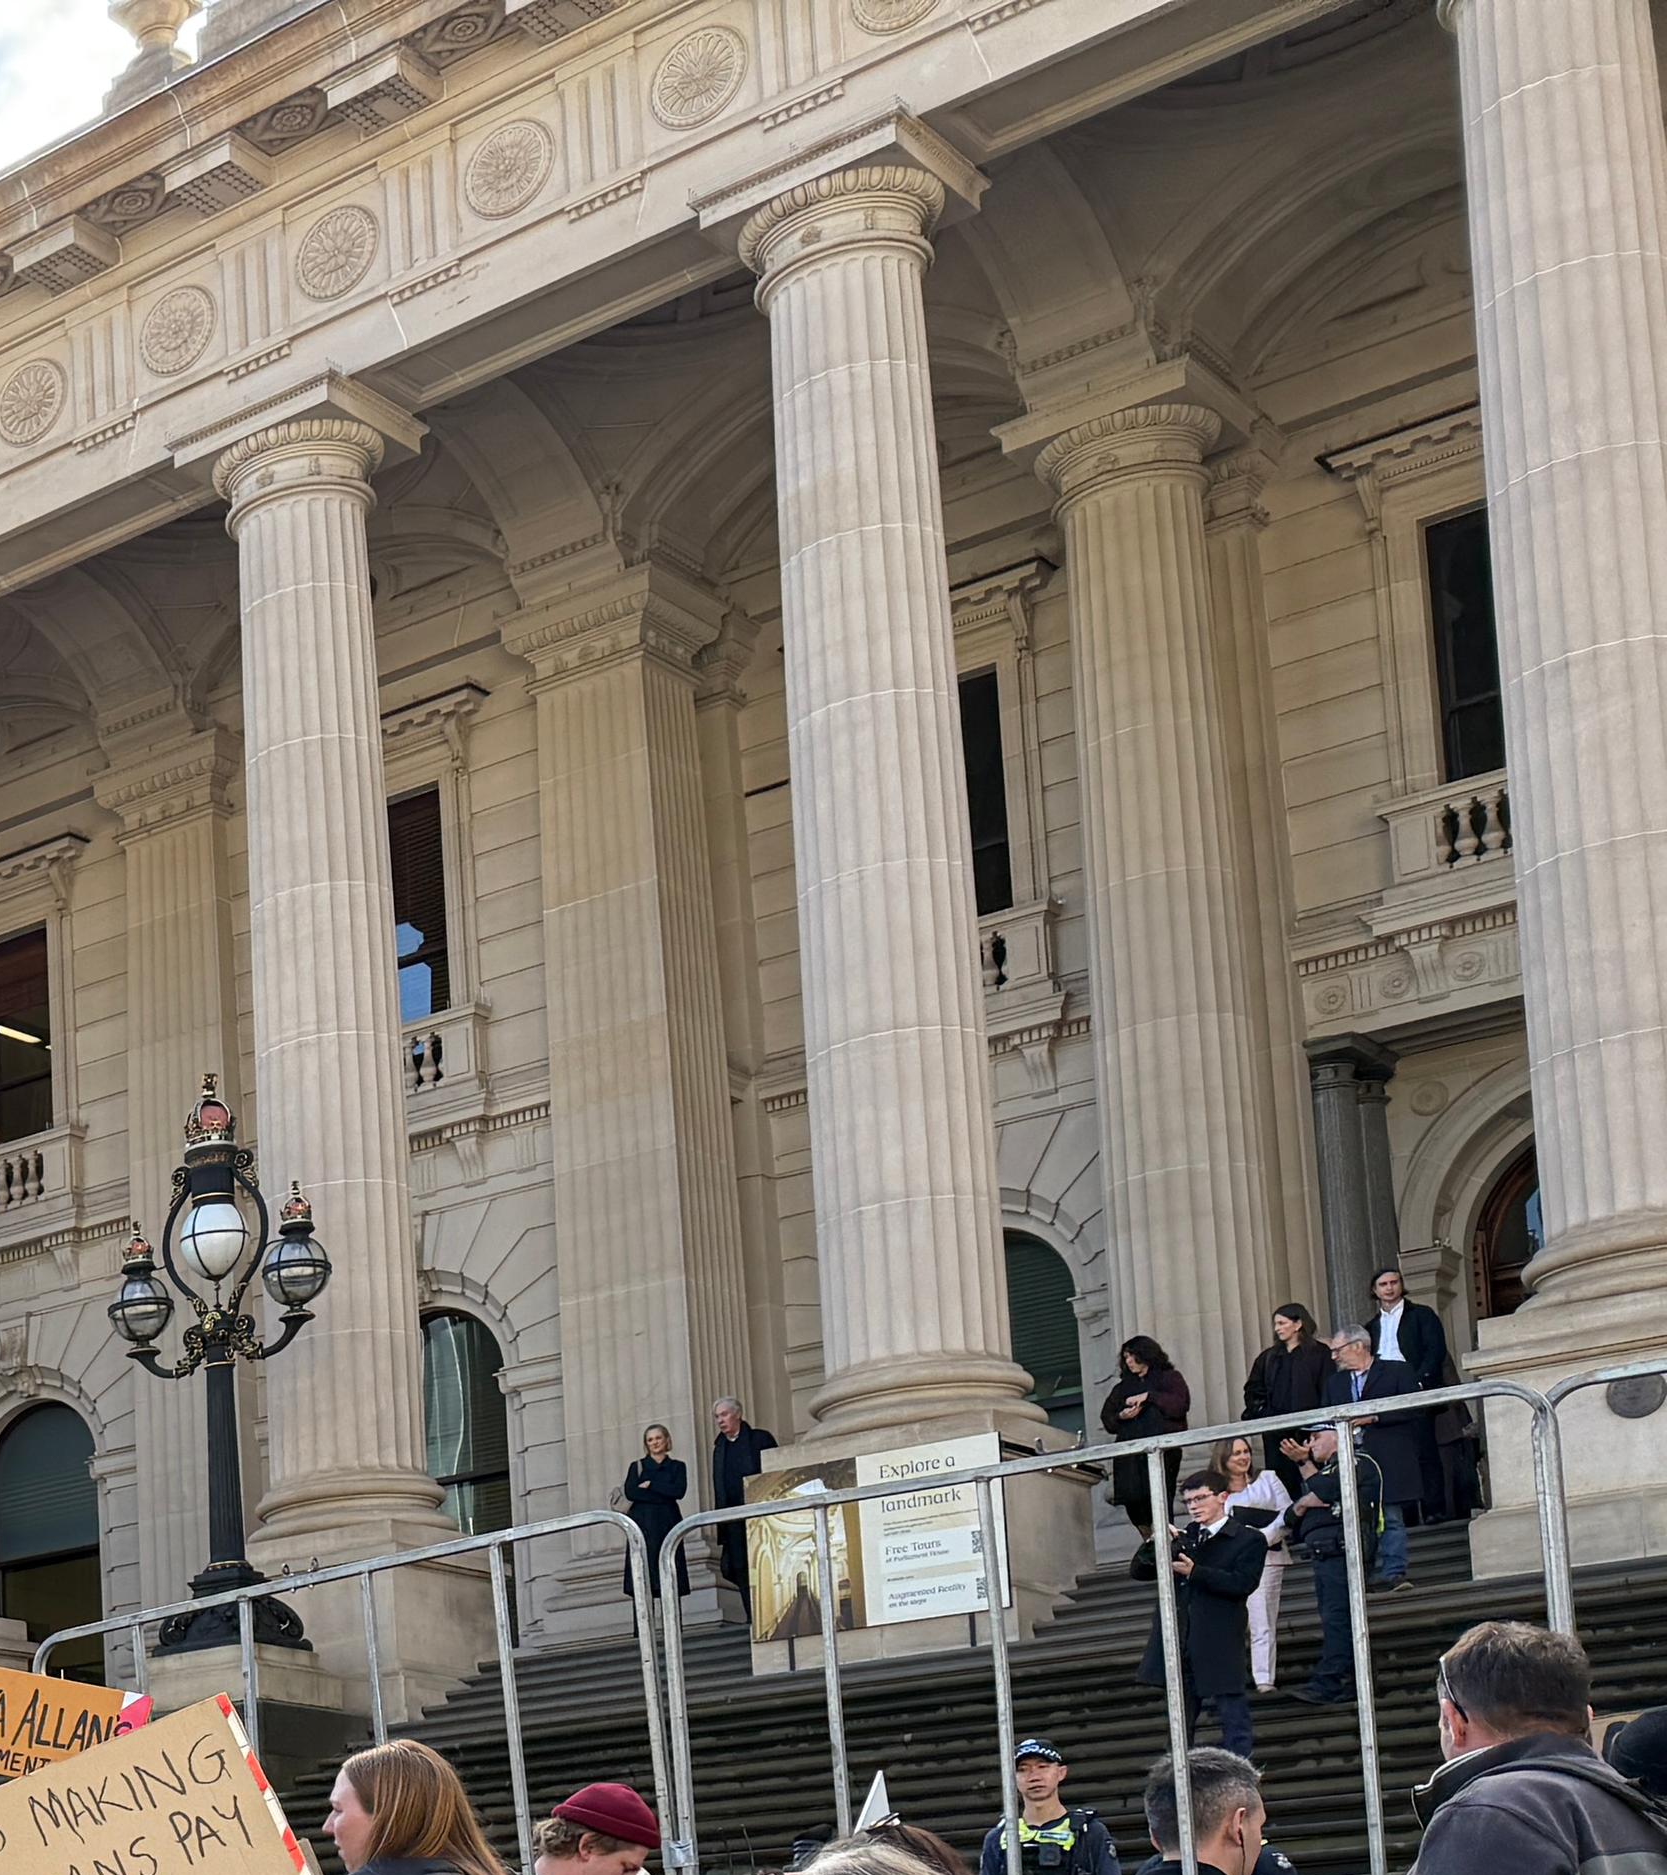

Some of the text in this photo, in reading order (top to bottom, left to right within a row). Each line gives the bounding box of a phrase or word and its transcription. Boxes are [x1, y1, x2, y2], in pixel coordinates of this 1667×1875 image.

[879, 1456, 956, 1479] Explore a
[881, 1488, 961, 1513] landmark
[885, 1540, 942, 1556] Free Tours
[28, 1733, 234, 1847] MAKING
[168, 1795, 255, 1866] PAY
